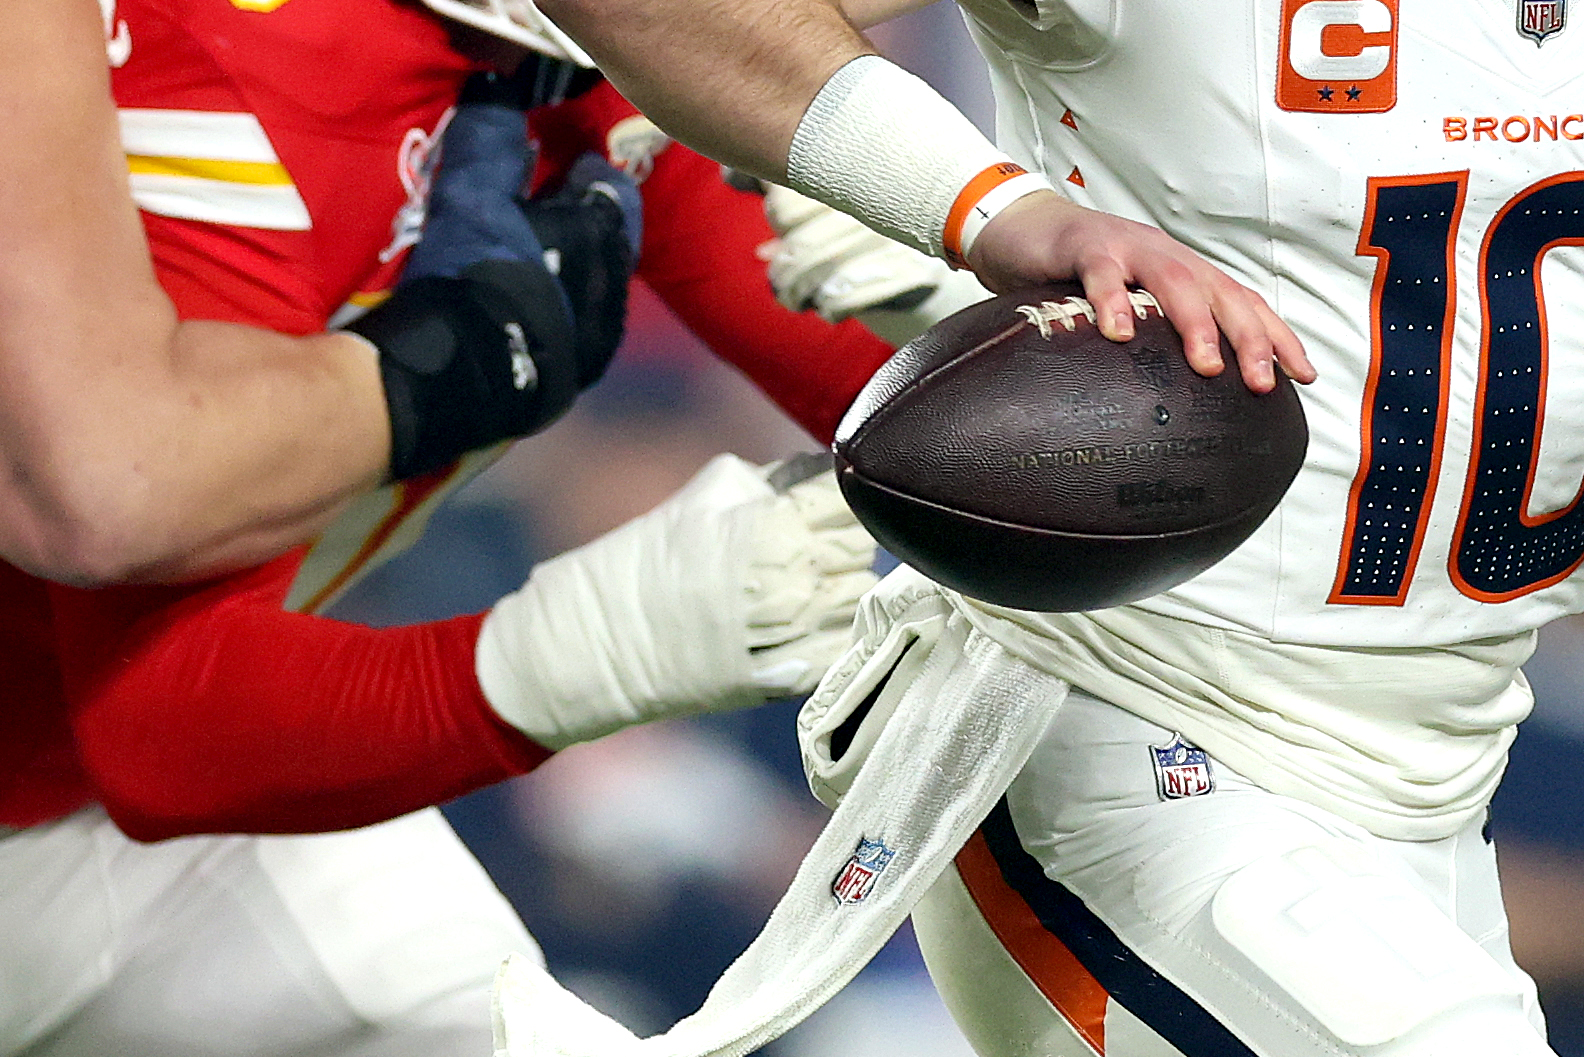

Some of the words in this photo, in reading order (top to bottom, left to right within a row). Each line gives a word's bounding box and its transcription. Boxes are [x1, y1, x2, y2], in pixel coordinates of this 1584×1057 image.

[1525, 3, 1561, 33] NFL
[1289, 0, 1393, 81] C
[1164, 766, 1208, 796] NFL
[836, 861, 874, 900] NFL
